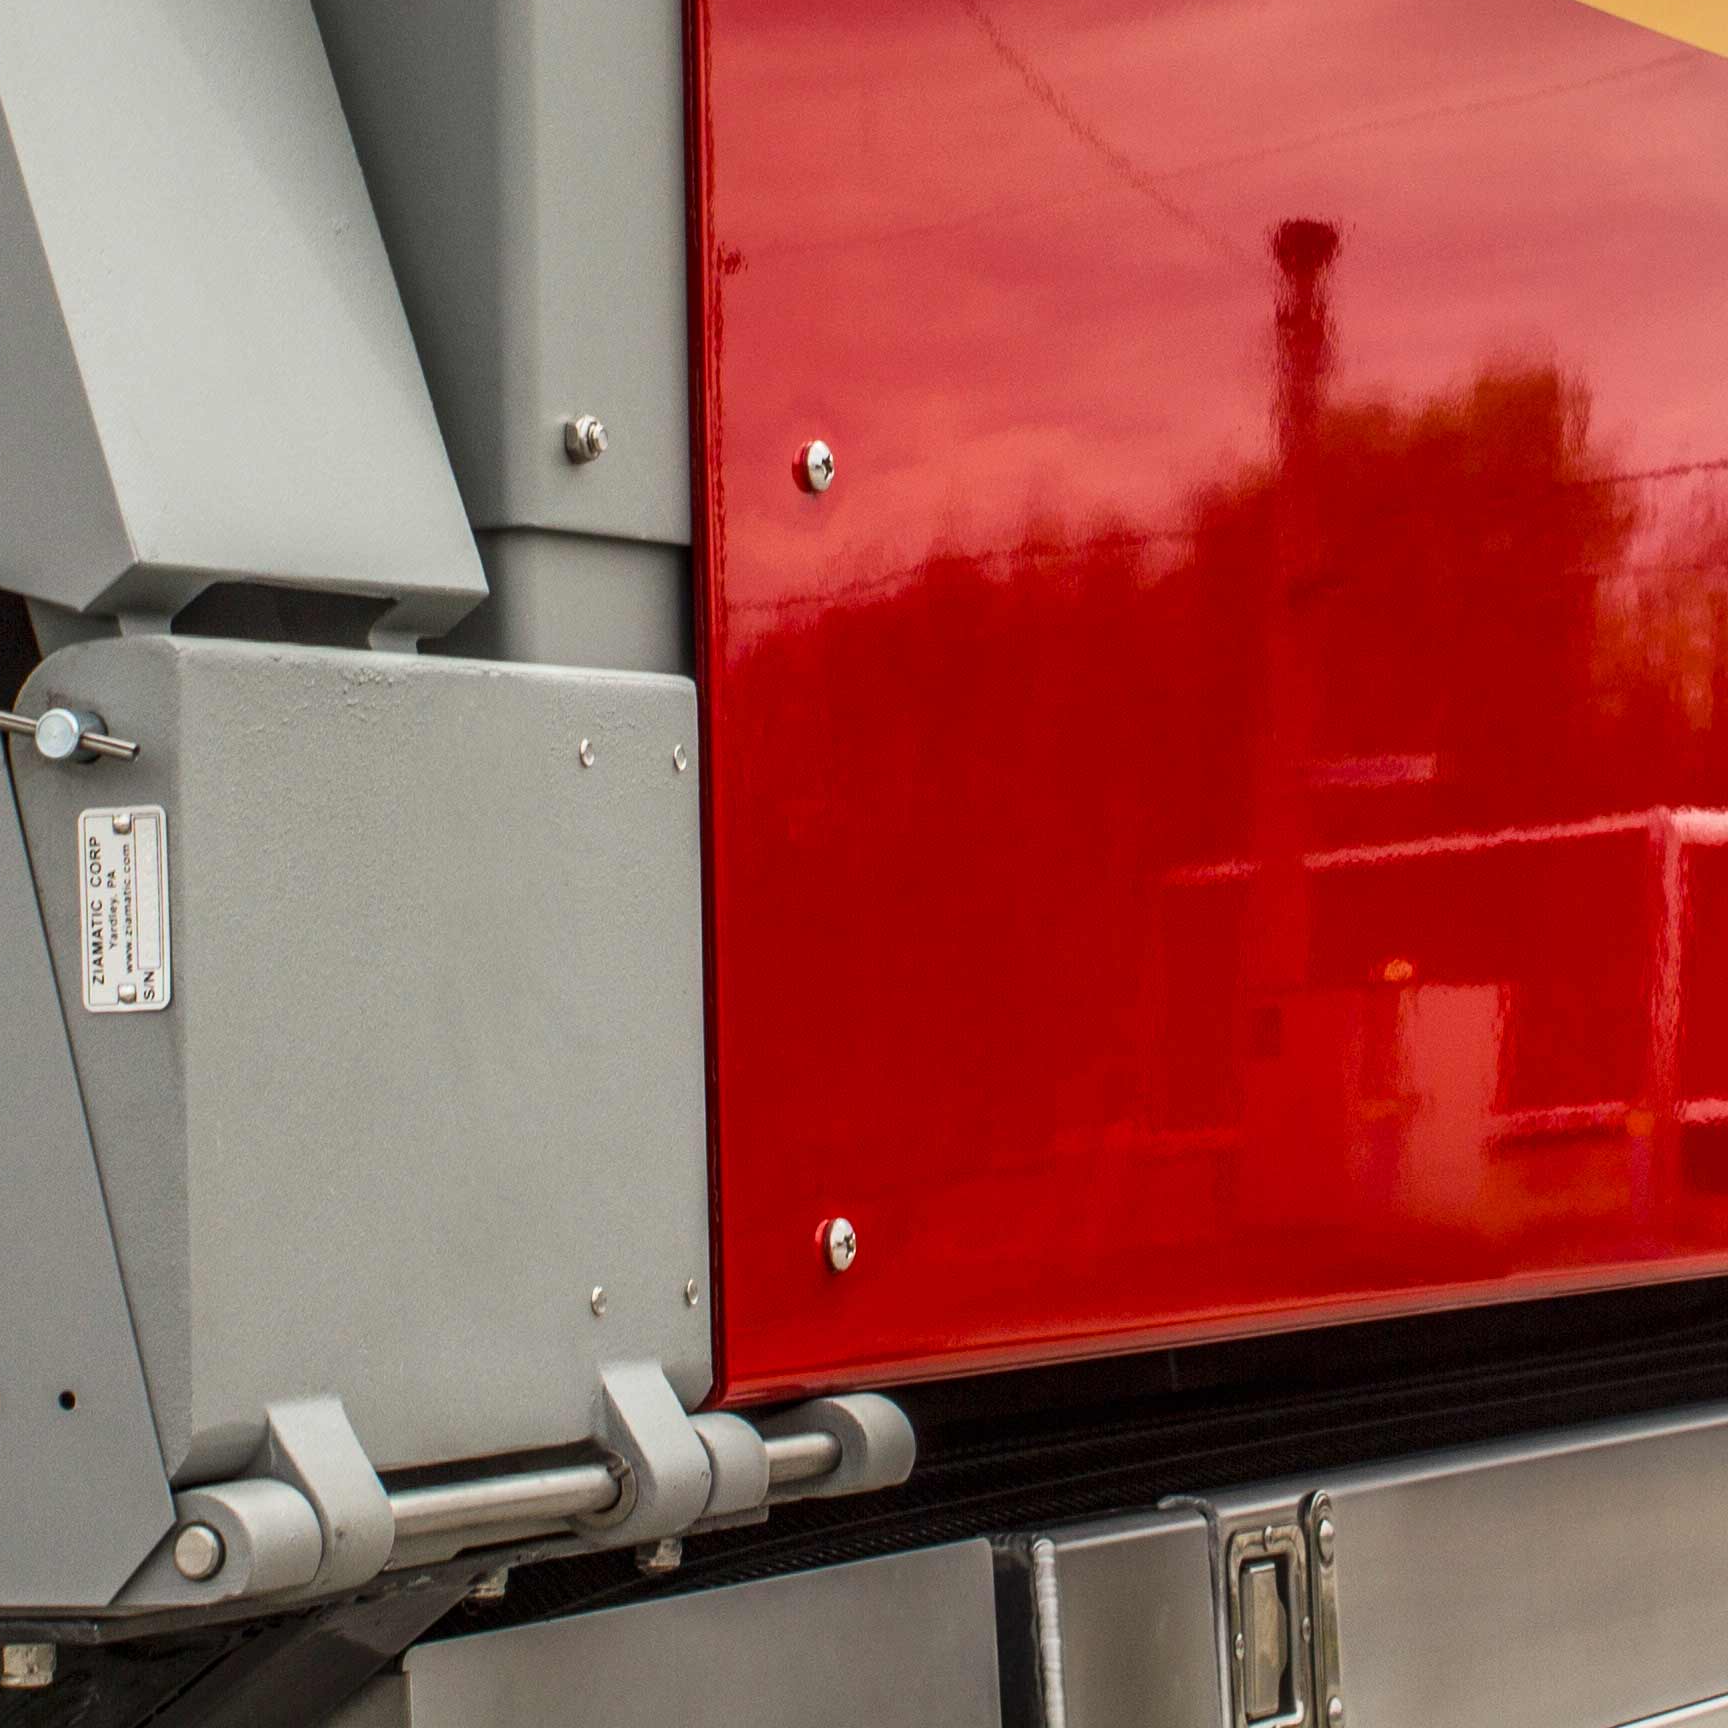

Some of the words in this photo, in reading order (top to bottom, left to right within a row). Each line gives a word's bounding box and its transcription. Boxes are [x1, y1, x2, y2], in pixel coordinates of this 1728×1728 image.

[89, 836, 102, 888] CORP
[107, 869, 117, 889] PA
[122, 843, 134, 974] www.ziamatic.com
[91, 899, 105, 985] ZIAMATIC
[143, 971, 156, 1000] S/N
